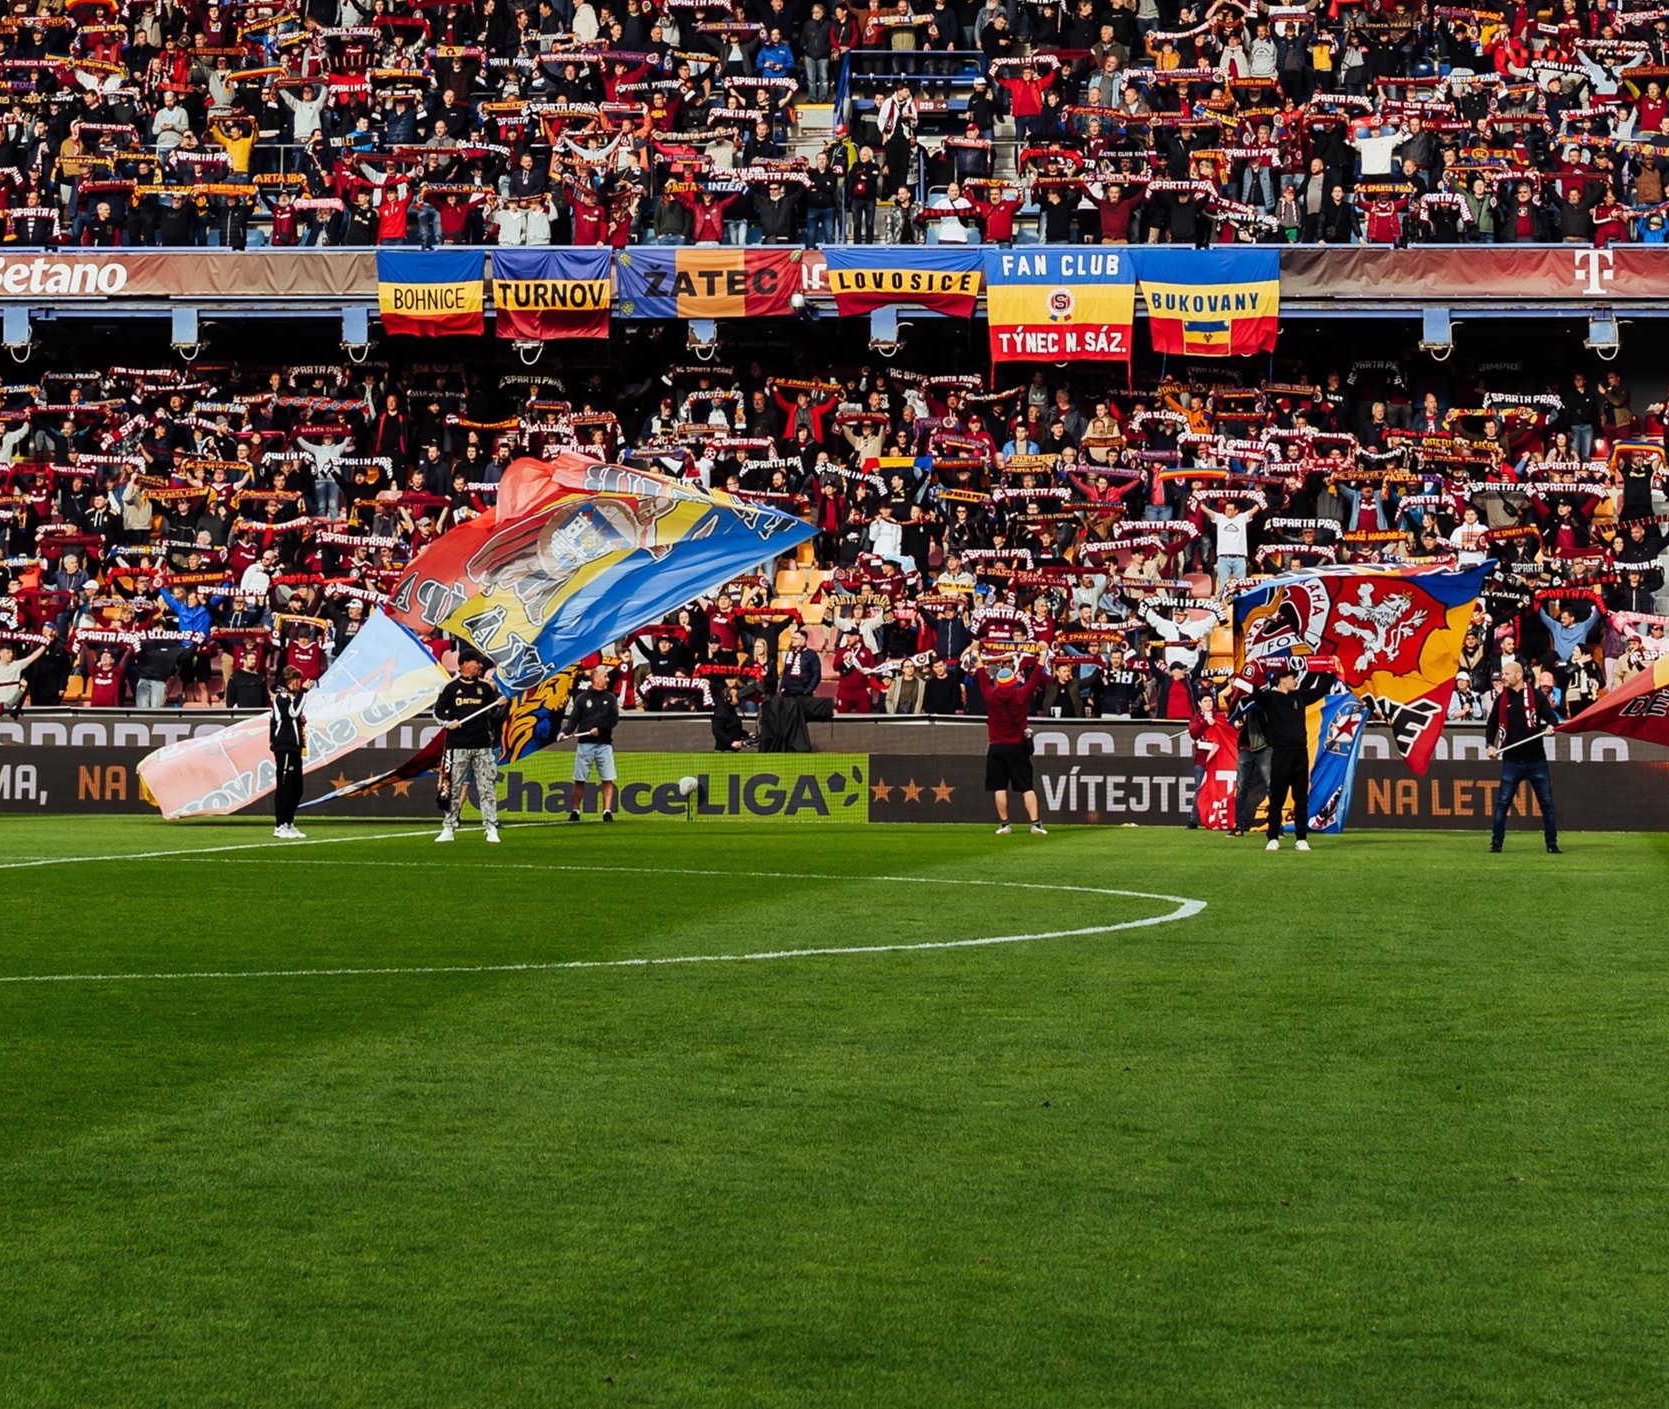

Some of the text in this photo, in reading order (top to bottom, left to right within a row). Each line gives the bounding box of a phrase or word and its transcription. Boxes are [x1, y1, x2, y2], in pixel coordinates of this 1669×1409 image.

[733, 76, 768, 86] SPARTA
[769, 77, 799, 90] PRAHA
[1094, 174, 1120, 182] SPARTA
[1001, 254, 1120, 276] FAN CLUB
[1575, 250, 1614, 294] T
[643, 264, 778, 298] ŽATEC
[838, 271, 971, 292] LOVOSICE
[394, 287, 465, 310] BOHNICE
[498, 282, 605, 308] TURNOV
[1151, 292, 1259, 313] BUKOVANY
[998, 325, 1127, 353] TÝNEC N. SÁZ.
[1490, 392, 1531, 403] SPARTA
[1538, 461, 1581, 471] SPARTA
[1582, 462, 1611, 477] PRAHA
[1196, 489, 1239, 500] SPARTA
[1239, 489, 1269, 510] PRAHA
[1120, 519, 1165, 530] SPARTA
[1167, 519, 1198, 538] PRAHA
[1272, 517, 1315, 528] SPARTA
[321, 531, 360, 545] SPARTA
[1144, 596, 1192, 608] SPARTA
[1193, 598, 1227, 622] PRAHA
[78, 765, 127, 800] NA
[1041, 766, 1196, 815] VÍTEJTE
[1367, 778, 1419, 816] NA
